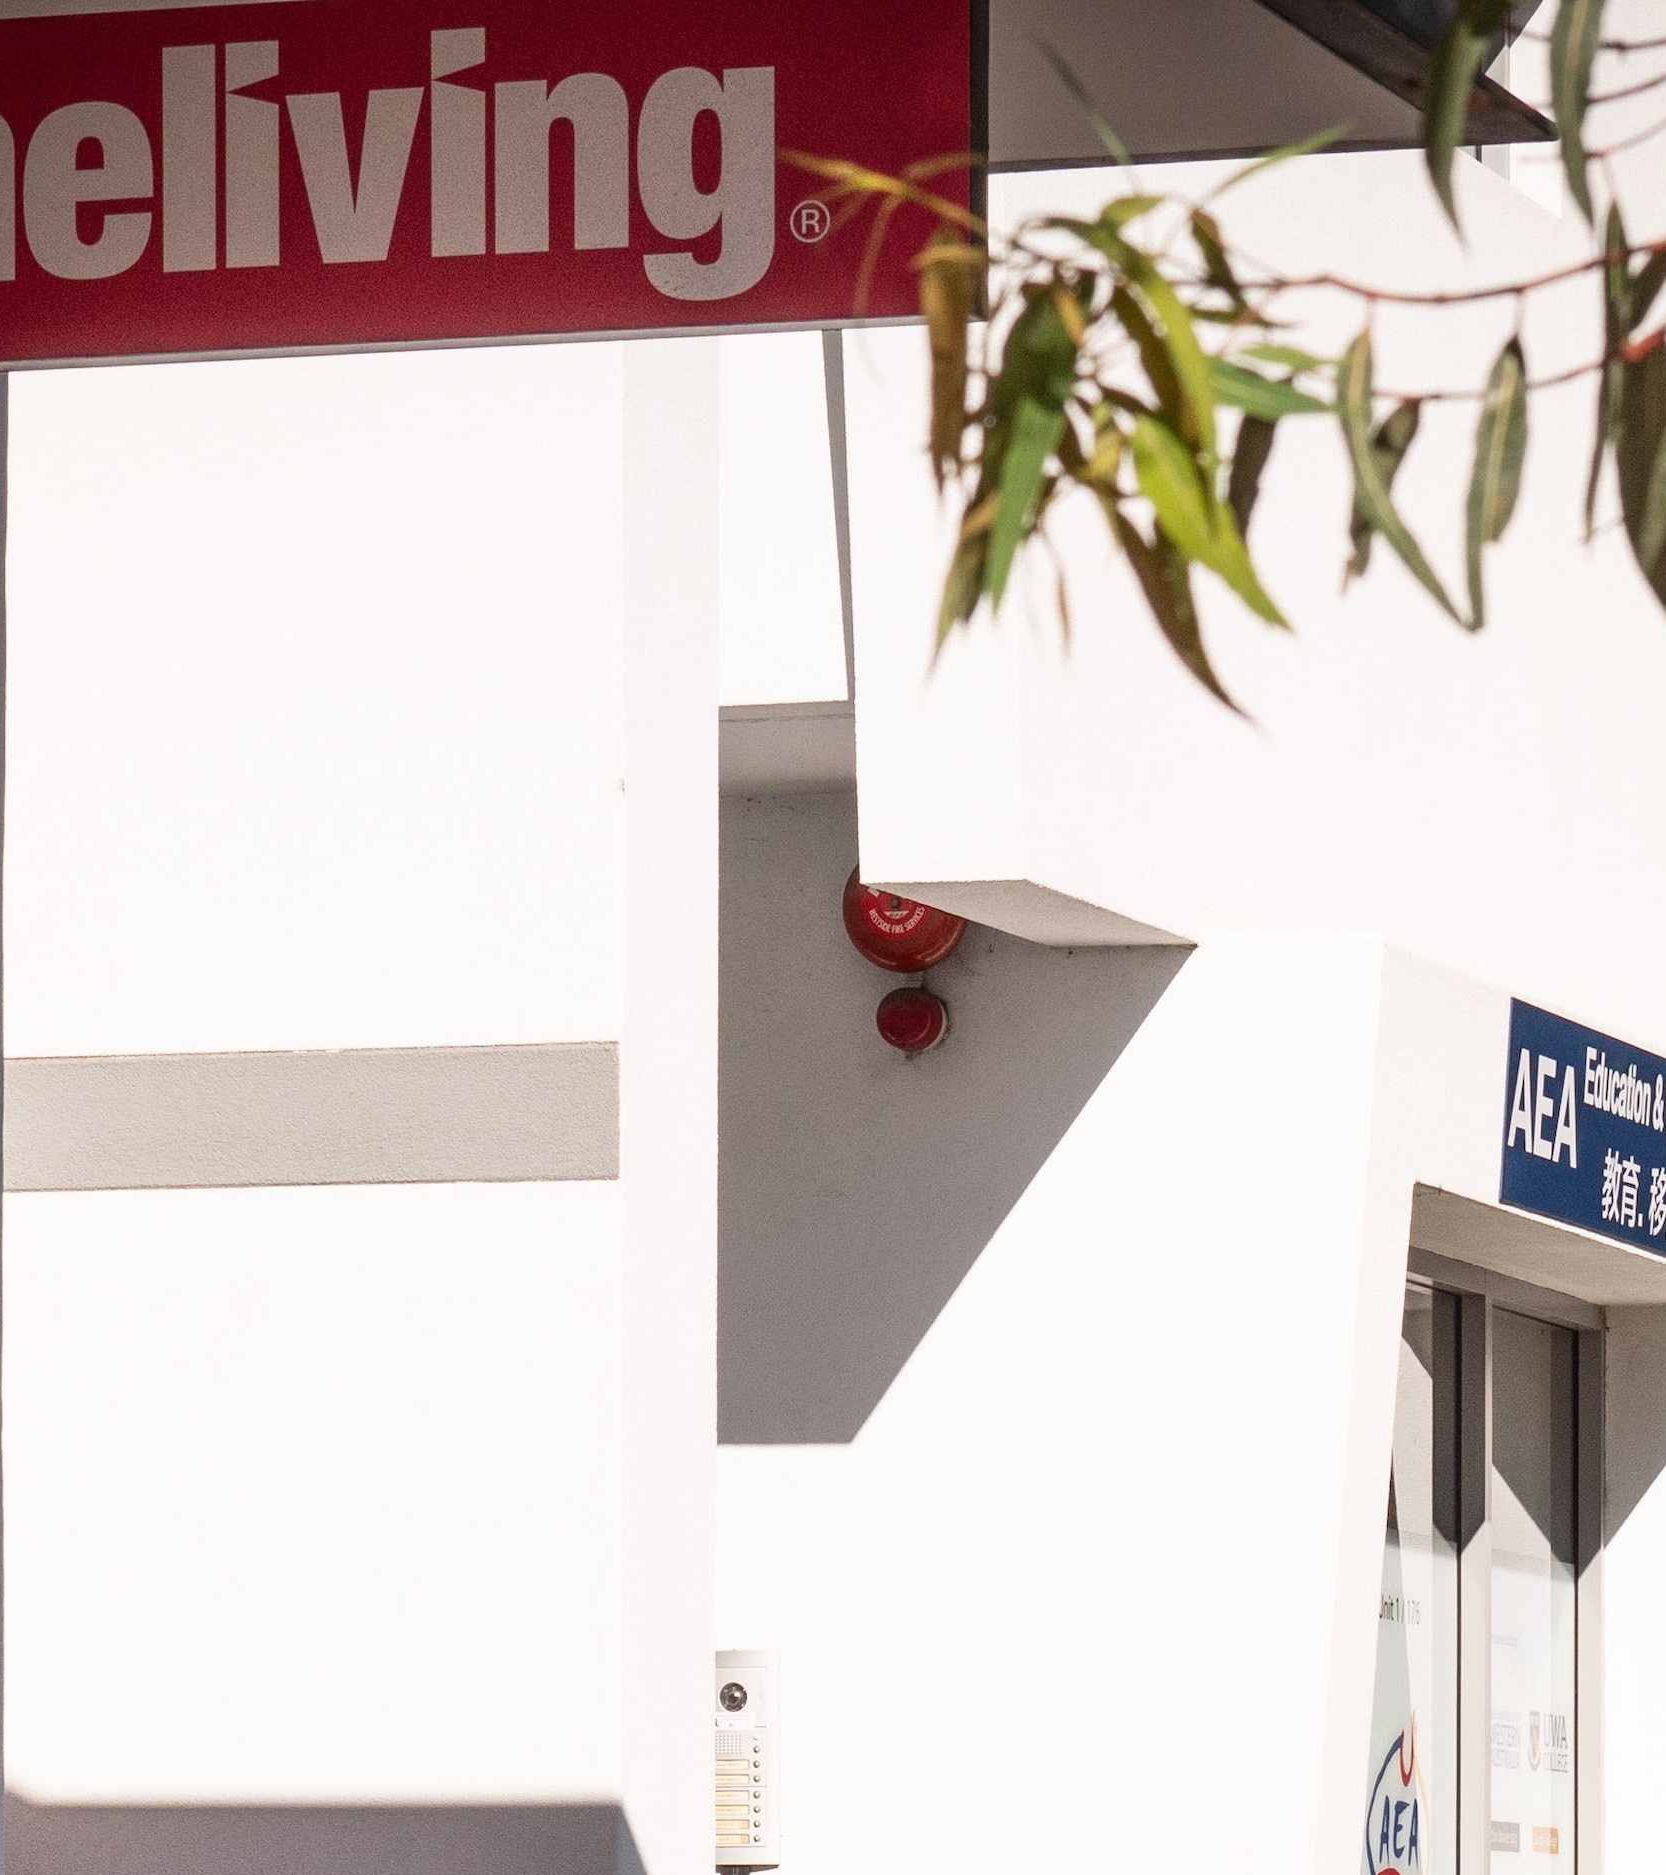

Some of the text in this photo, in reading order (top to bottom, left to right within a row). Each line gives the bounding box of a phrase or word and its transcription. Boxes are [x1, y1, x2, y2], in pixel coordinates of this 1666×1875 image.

[1507, 1047, 1579, 1169] AEA
[1583, 1046, 1651, 1126] Education
[1652, 1073, 1665, 1131] &
[1379, 1795, 1419, 1871] AEA
